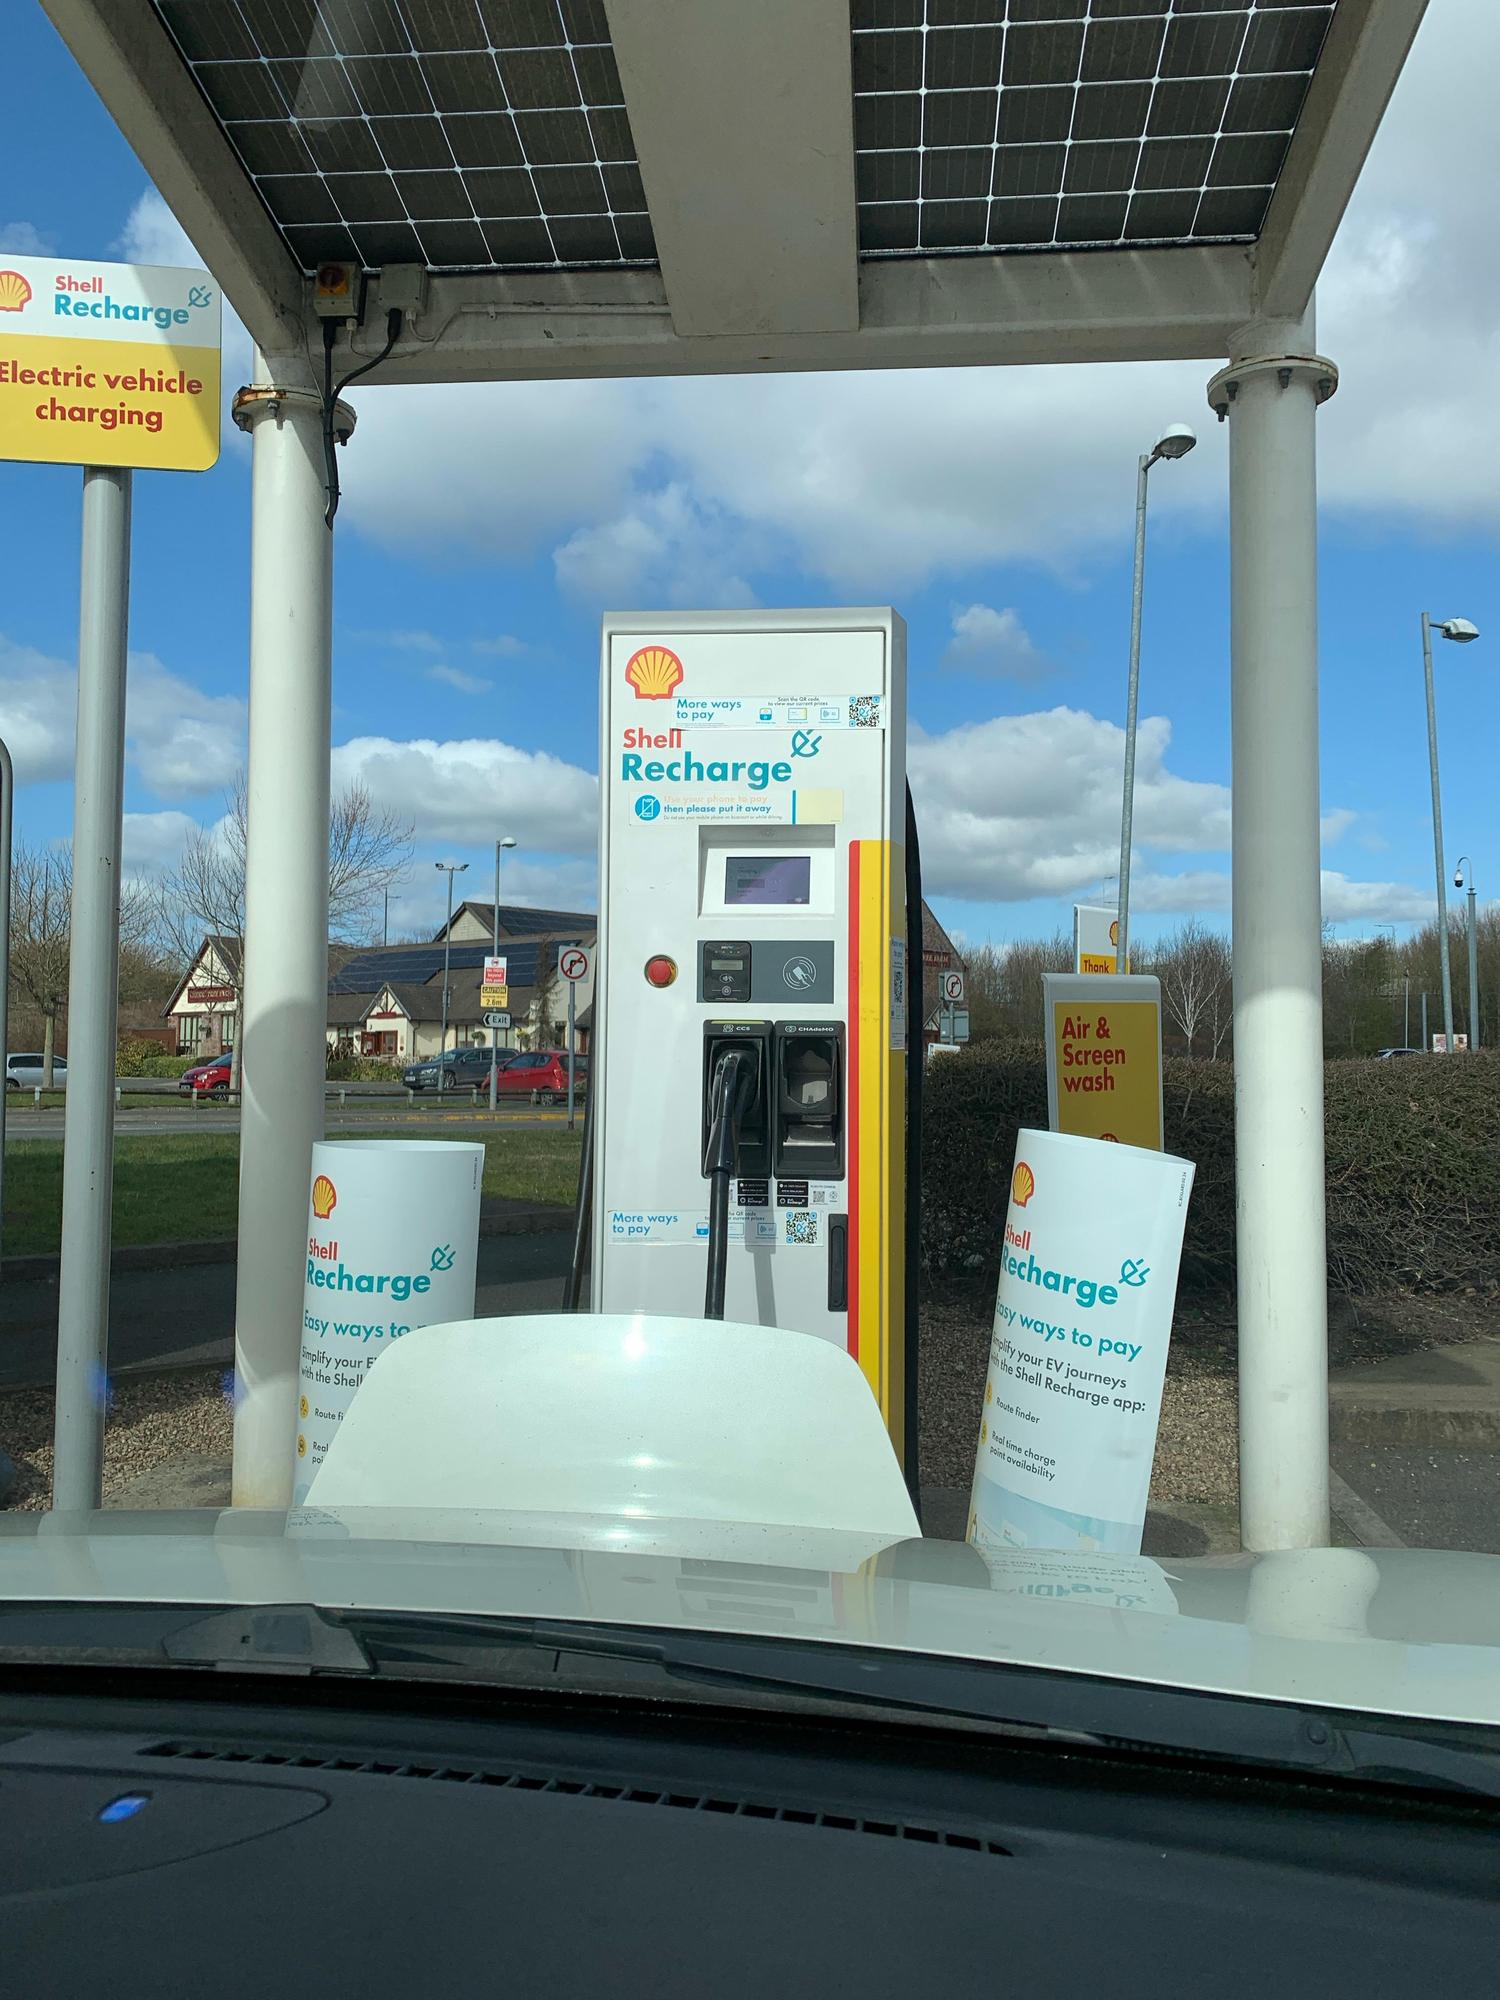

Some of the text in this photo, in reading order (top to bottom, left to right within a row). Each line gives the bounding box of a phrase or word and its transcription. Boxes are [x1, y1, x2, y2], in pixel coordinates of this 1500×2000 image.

[55, 275, 103, 293] Shell
[54, 294, 189, 329] Recharge
[0, 360, 203, 395] Electric vehicle
[35, 397, 163, 433] charging
[676, 698, 742, 712] More ways
[676, 709, 714, 722] to pay
[622, 728, 682, 749] Shell
[621, 751, 792, 791] Recharge
[663, 804, 772, 815] then please put it away
[706, 795, 737, 805] phone
[749, 797, 768, 805] pay
[1083, 959, 1110, 974] Thank
[492, 1015, 507, 1024] Exit
[1061, 1016, 1111, 1039] Air &
[1062, 1043, 1126, 1067] Screen
[1063, 1067, 1115, 1093] wash
[612, 1213, 678, 1226] More ways
[612, 1224, 651, 1236] to pay
[308, 1237, 338, 1261] Shell
[1004, 1223, 1032, 1252] Shell
[306, 1259, 431, 1301] Recharge
[1000, 1246, 1119, 1308] Recharge
[304, 1309, 329, 1338] Easy
[333, 1322, 384, 1343] ways
[1019, 1314, 1066, 1342] ways
[1071, 1328, 1093, 1348] to
[1099, 1337, 1142, 1363] pay
[301, 1345, 332, 1369] Simplify
[334, 1357, 363, 1370] your
[301, 1366, 363, 1388] with the Shell
[1017, 1350, 1044, 1367] your
[1046, 1357, 1064, 1374] EV
[1064, 1363, 1128, 1391] journeys
[1000, 1358, 1014, 1375] the
[1015, 1366, 1042, 1387] Shell
[1044, 1377, 1110, 1406] Recharge
[1112, 1395, 1146, 1414] app:
[314, 1407, 336, 1420] Route
[996, 1396, 1041, 1425] Route finder
[312, 1441, 329, 1452] Real
[991, 1430, 1056, 1467] Real time charge
[311, 1456, 324, 1465] poi
[989, 1446, 1056, 1482] point availability
